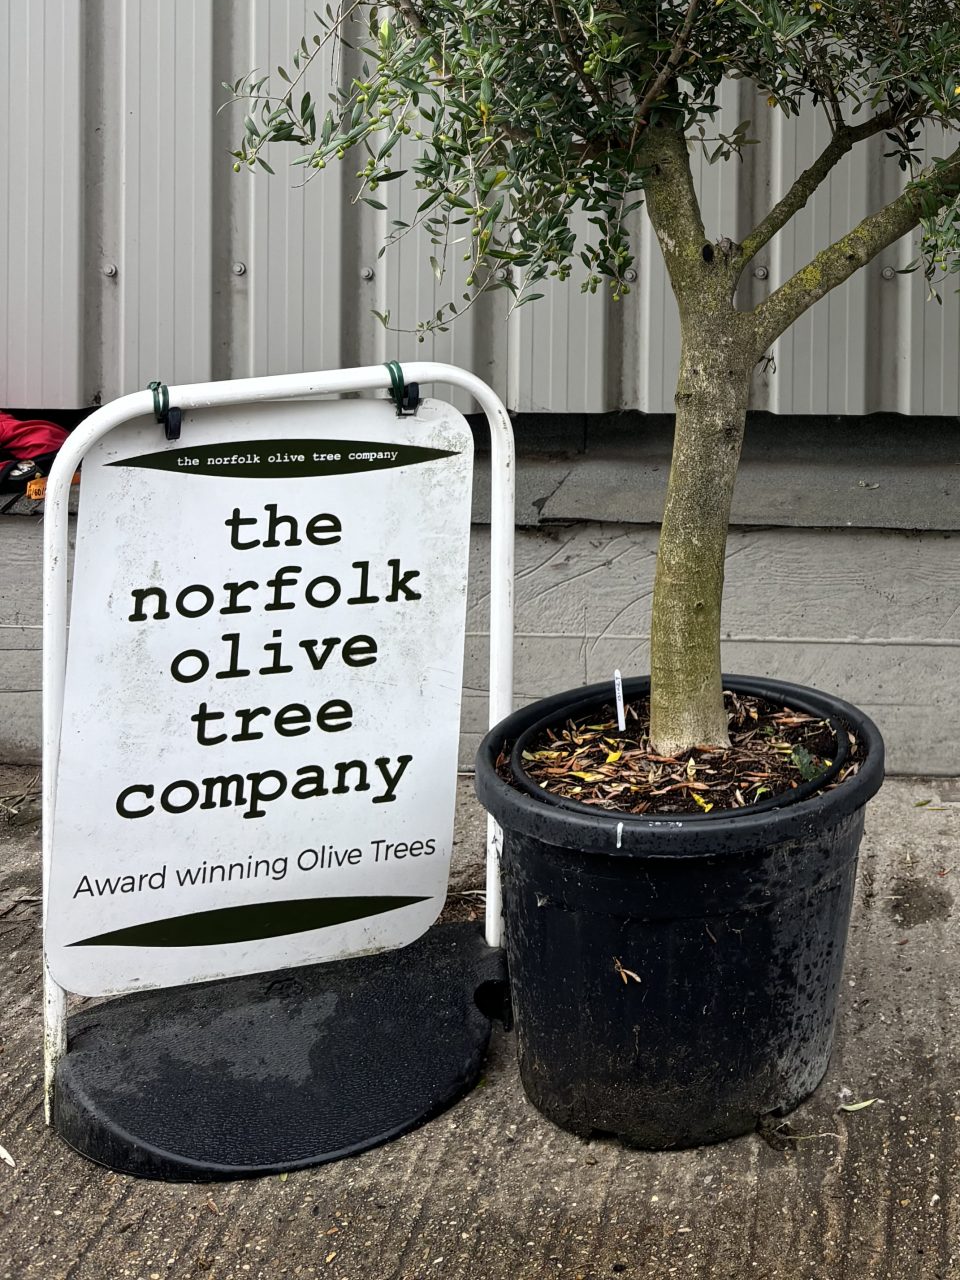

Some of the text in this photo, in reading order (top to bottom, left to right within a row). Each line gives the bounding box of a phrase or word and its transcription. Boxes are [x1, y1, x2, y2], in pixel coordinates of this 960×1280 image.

[177, 450, 399, 467] the norfolk olive tree company
[225, 504, 342, 550] the
[129, 559, 422, 622] norfolk
[170, 629, 378, 684] olive
[191, 700, 353, 746] tree
[116, 755, 413, 819] company
[73, 838, 436, 898] Award winning Olive Trees
